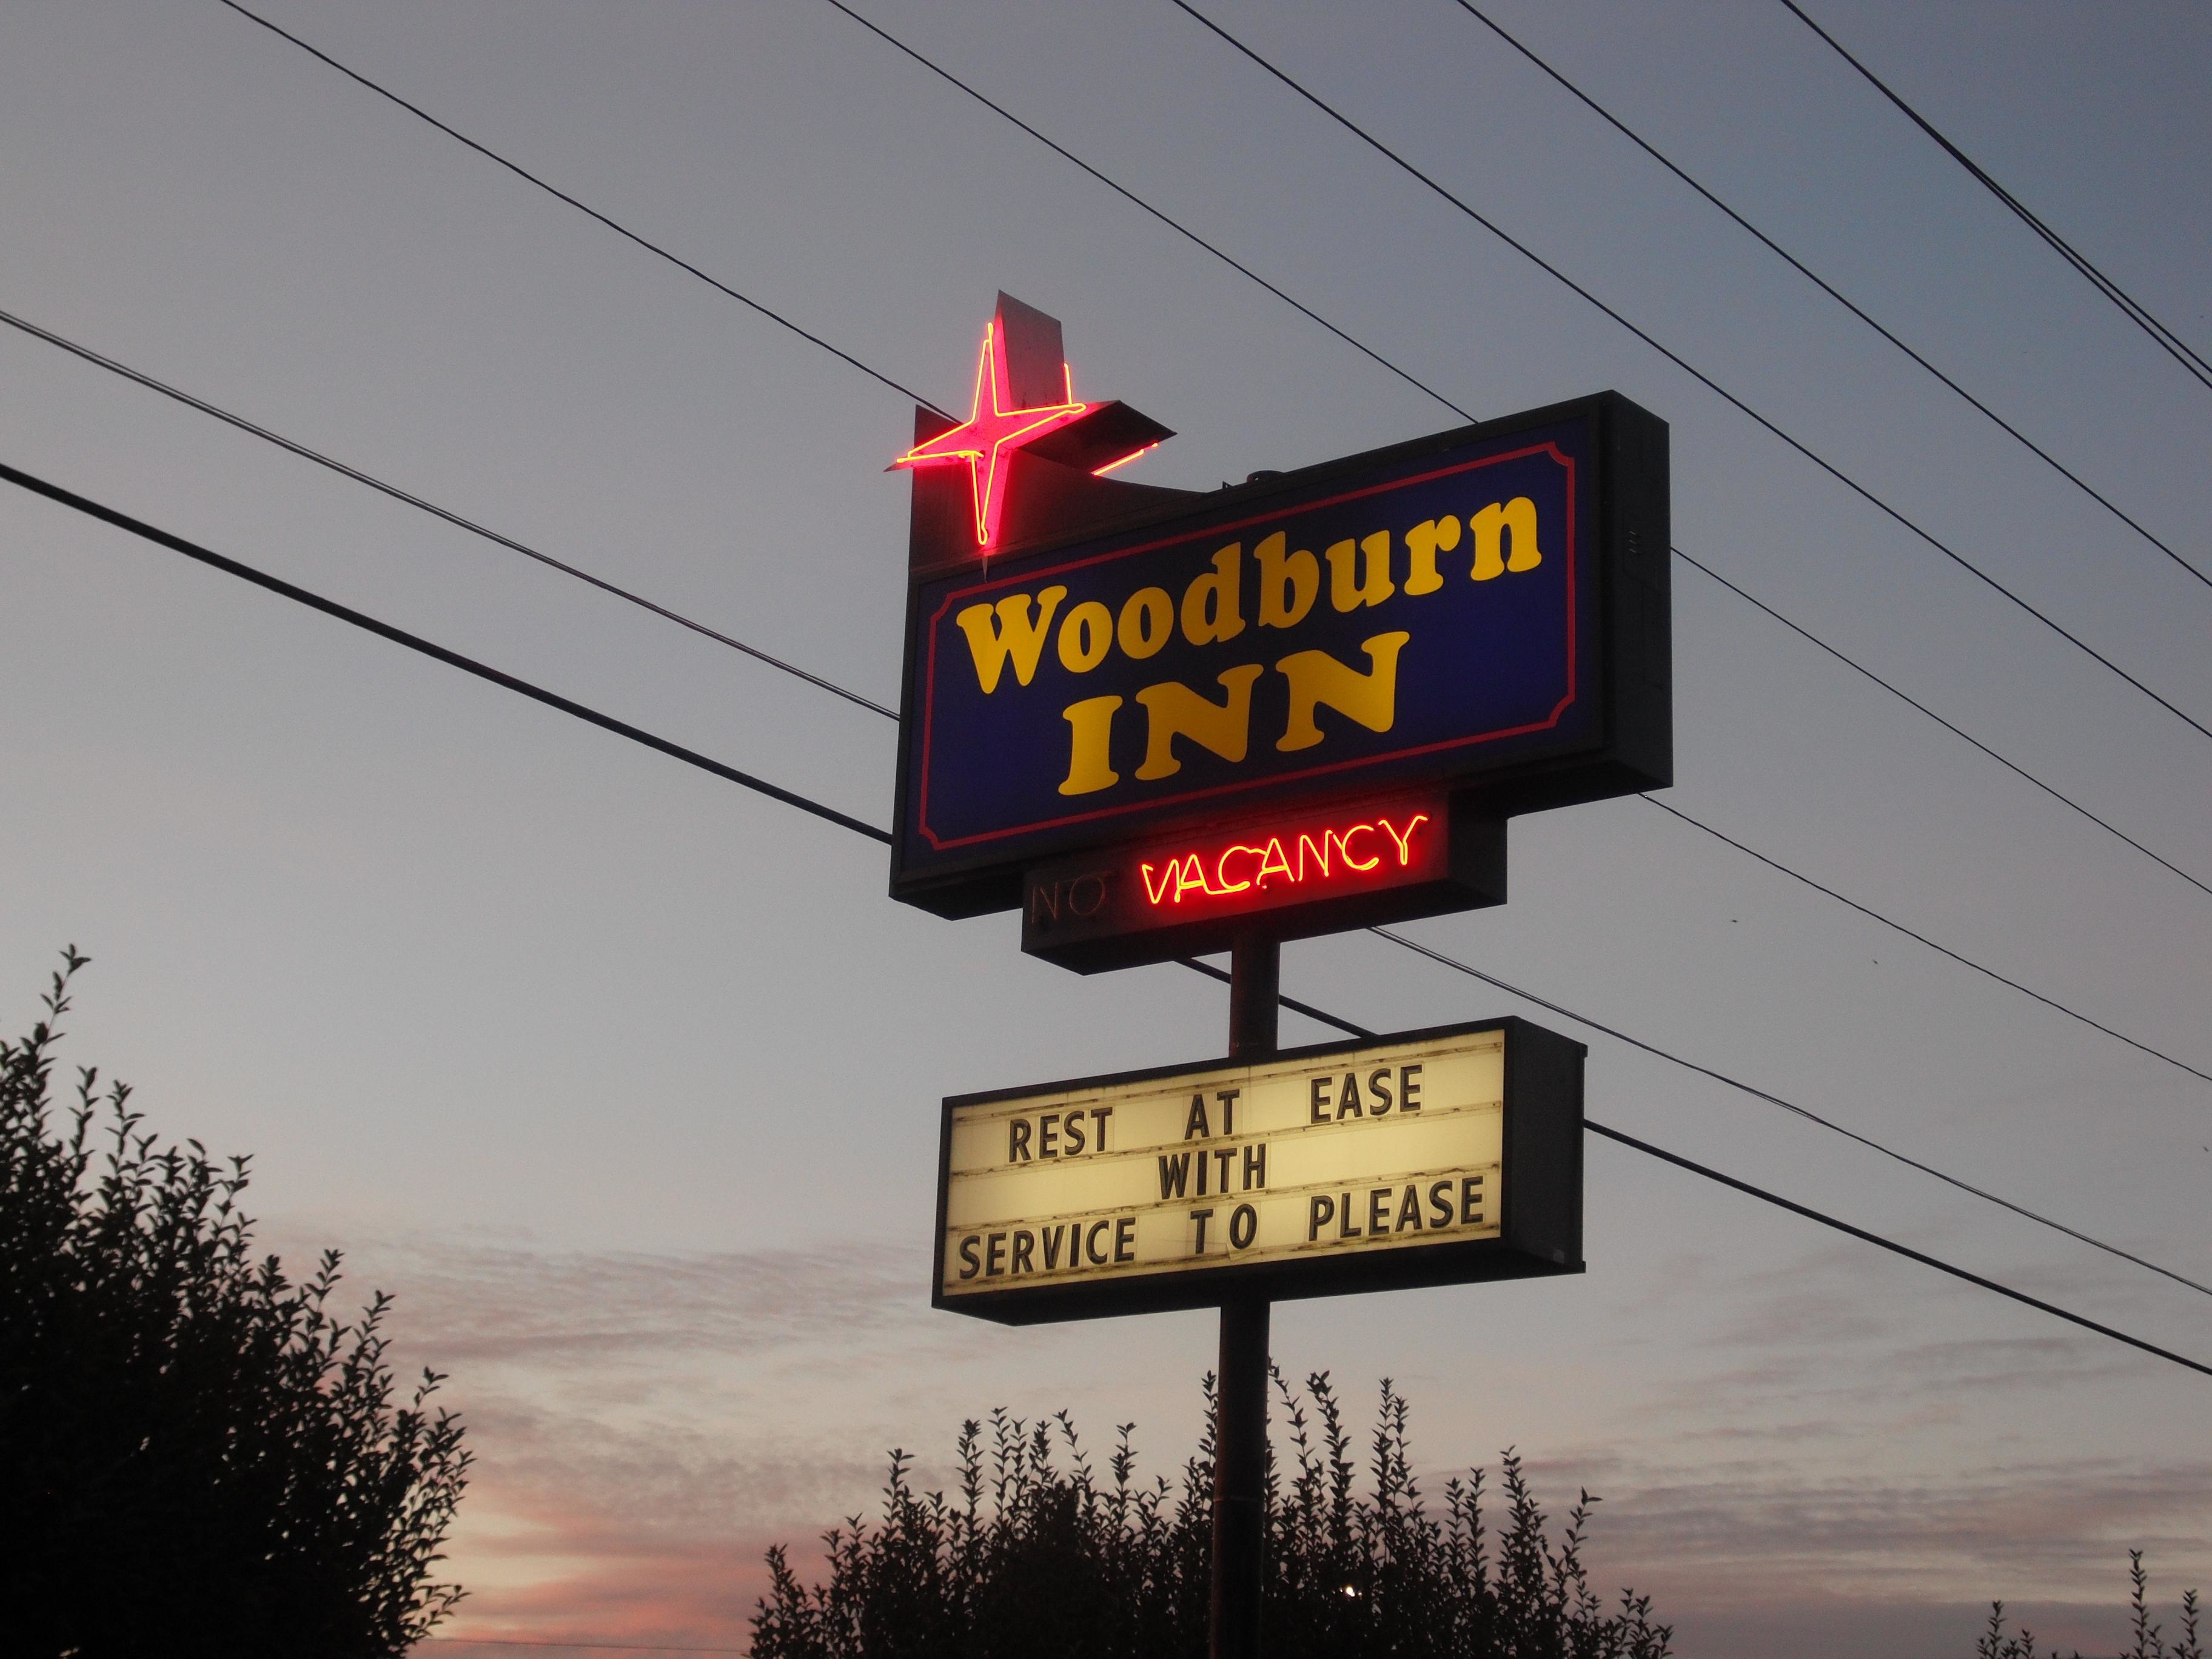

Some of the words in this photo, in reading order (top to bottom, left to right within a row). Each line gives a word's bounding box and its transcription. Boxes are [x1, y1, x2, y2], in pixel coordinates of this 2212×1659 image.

[956, 496, 1542, 694] Woodburn
[1058, 631, 1410, 796] INN
[1031, 874, 1108, 924] NO
[1141, 814, 1429, 905] VACANCY
[1008, 1107, 1113, 1163] REST
[1184, 1089, 1240, 1141] AT
[1310, 1064, 1424, 1124] EASE
[1158, 1143, 1267, 1200] WITH
[959, 1216, 1136, 1279] SERVICE
[1190, 1204, 1258, 1255] TO
[1309, 1176, 1484, 1242] PLEASE
